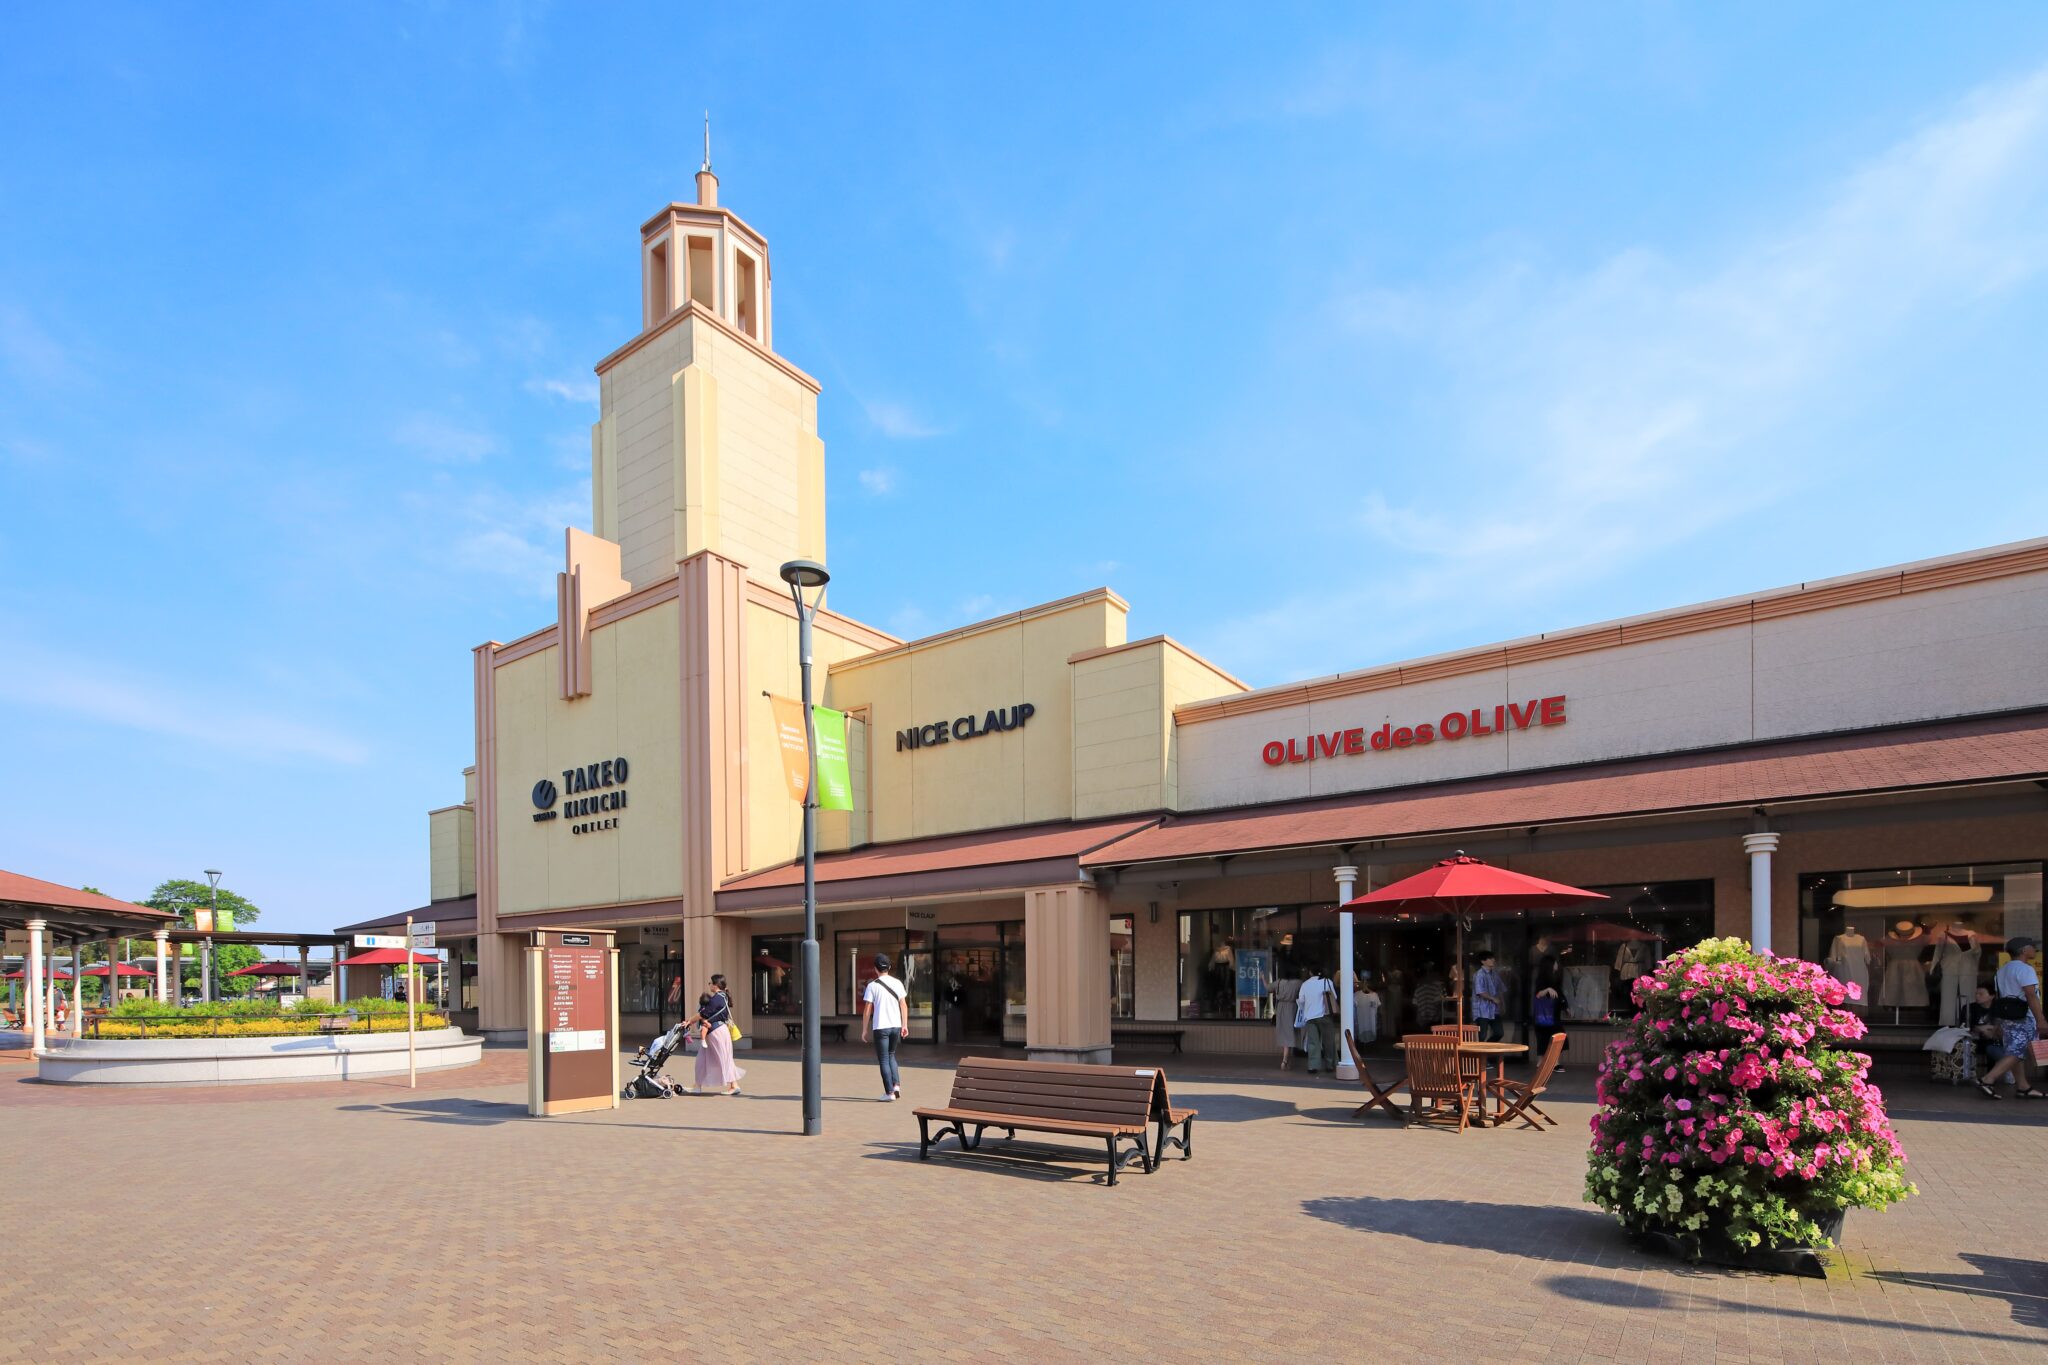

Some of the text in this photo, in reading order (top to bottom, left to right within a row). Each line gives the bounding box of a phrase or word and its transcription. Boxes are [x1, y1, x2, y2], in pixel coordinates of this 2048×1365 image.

[896, 703, 1034, 752] NICE CLAUP
[1262, 695, 1567, 766] OLIVE des OLIVE
[562, 757, 628, 795] TAKEO
[563, 790, 627, 819] KIKUCHI
[572, 818, 619, 835] OUTLET
